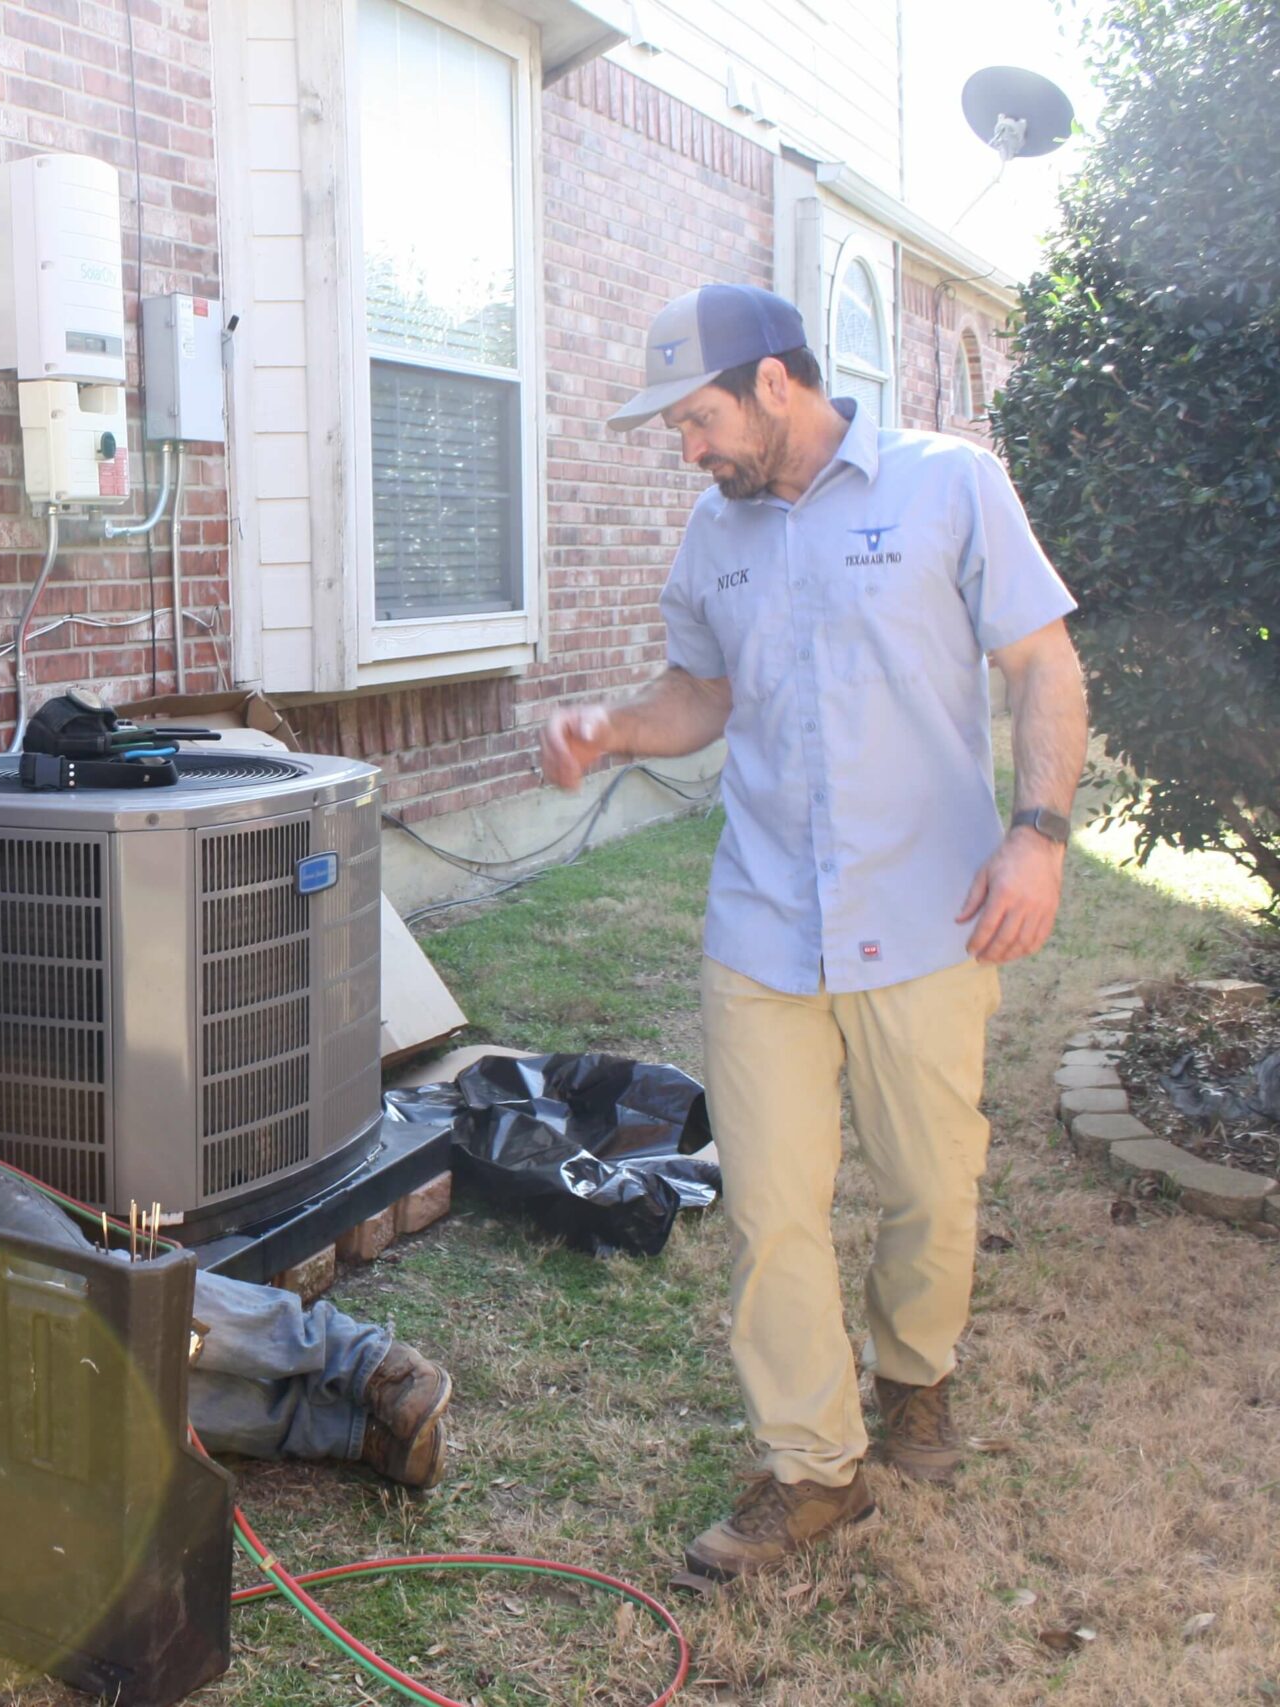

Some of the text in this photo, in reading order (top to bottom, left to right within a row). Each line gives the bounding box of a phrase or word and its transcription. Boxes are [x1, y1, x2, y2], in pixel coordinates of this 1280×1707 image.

[845, 551, 902, 567] TEXAS AIR PRO
[717, 568, 750, 592] NICK
